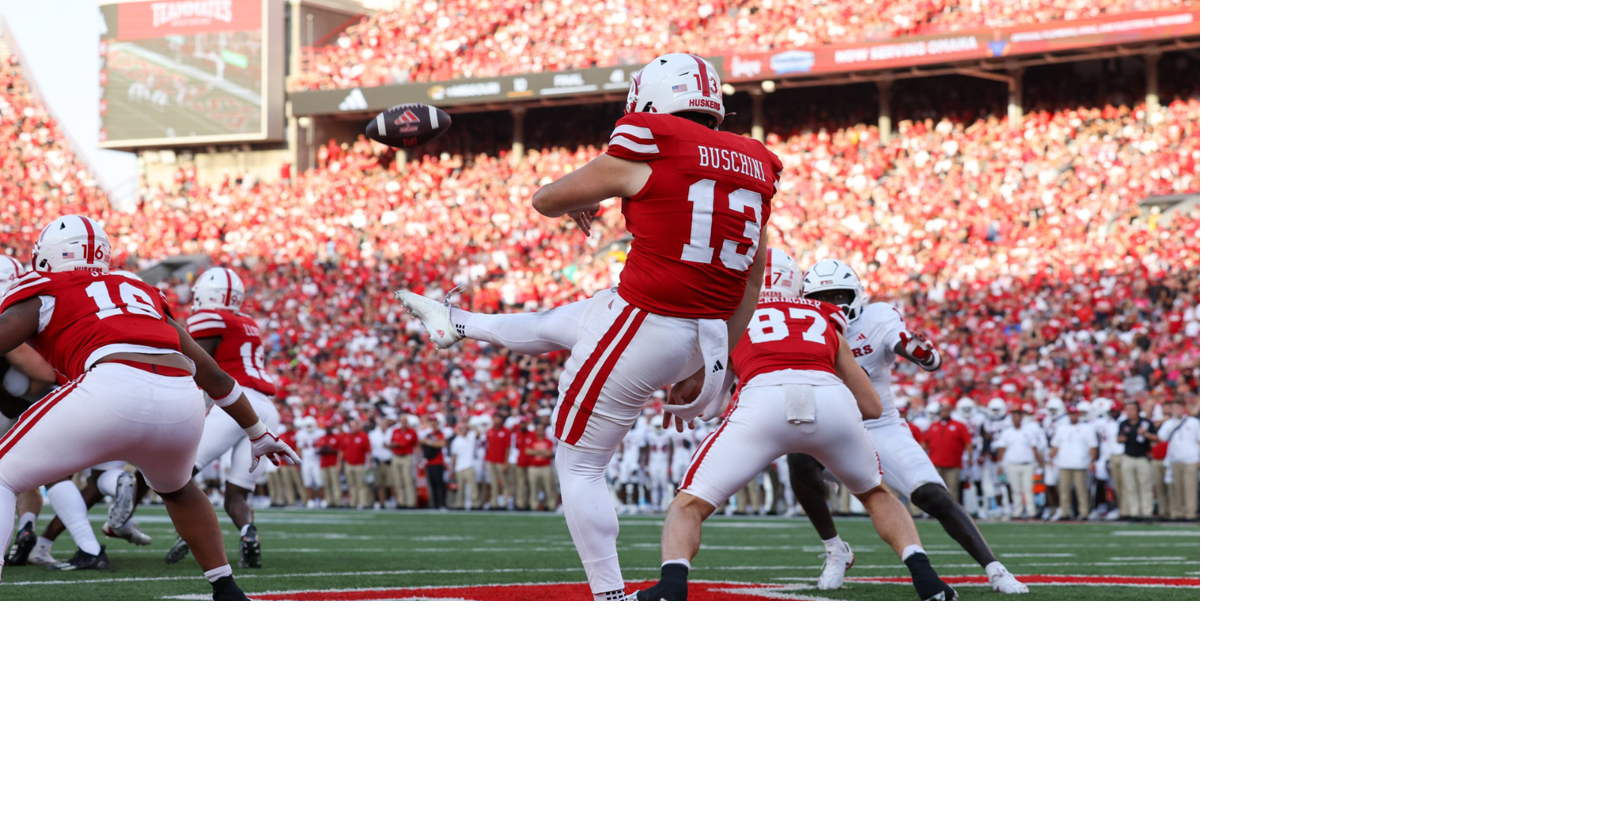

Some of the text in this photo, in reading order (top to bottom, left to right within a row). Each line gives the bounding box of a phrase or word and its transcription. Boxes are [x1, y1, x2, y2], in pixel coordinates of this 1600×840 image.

[152, 0, 233, 27] TEAMMATES
[834, 48, 869, 64] NOW
[869, 41, 927, 60] SERVING
[689, 99, 721, 111] HUSKERS
[698, 145, 766, 182] BUSCHINI
[680, 178, 763, 272] 13
[82, 244, 103, 260] 16
[747, 307, 827, 344] 87
